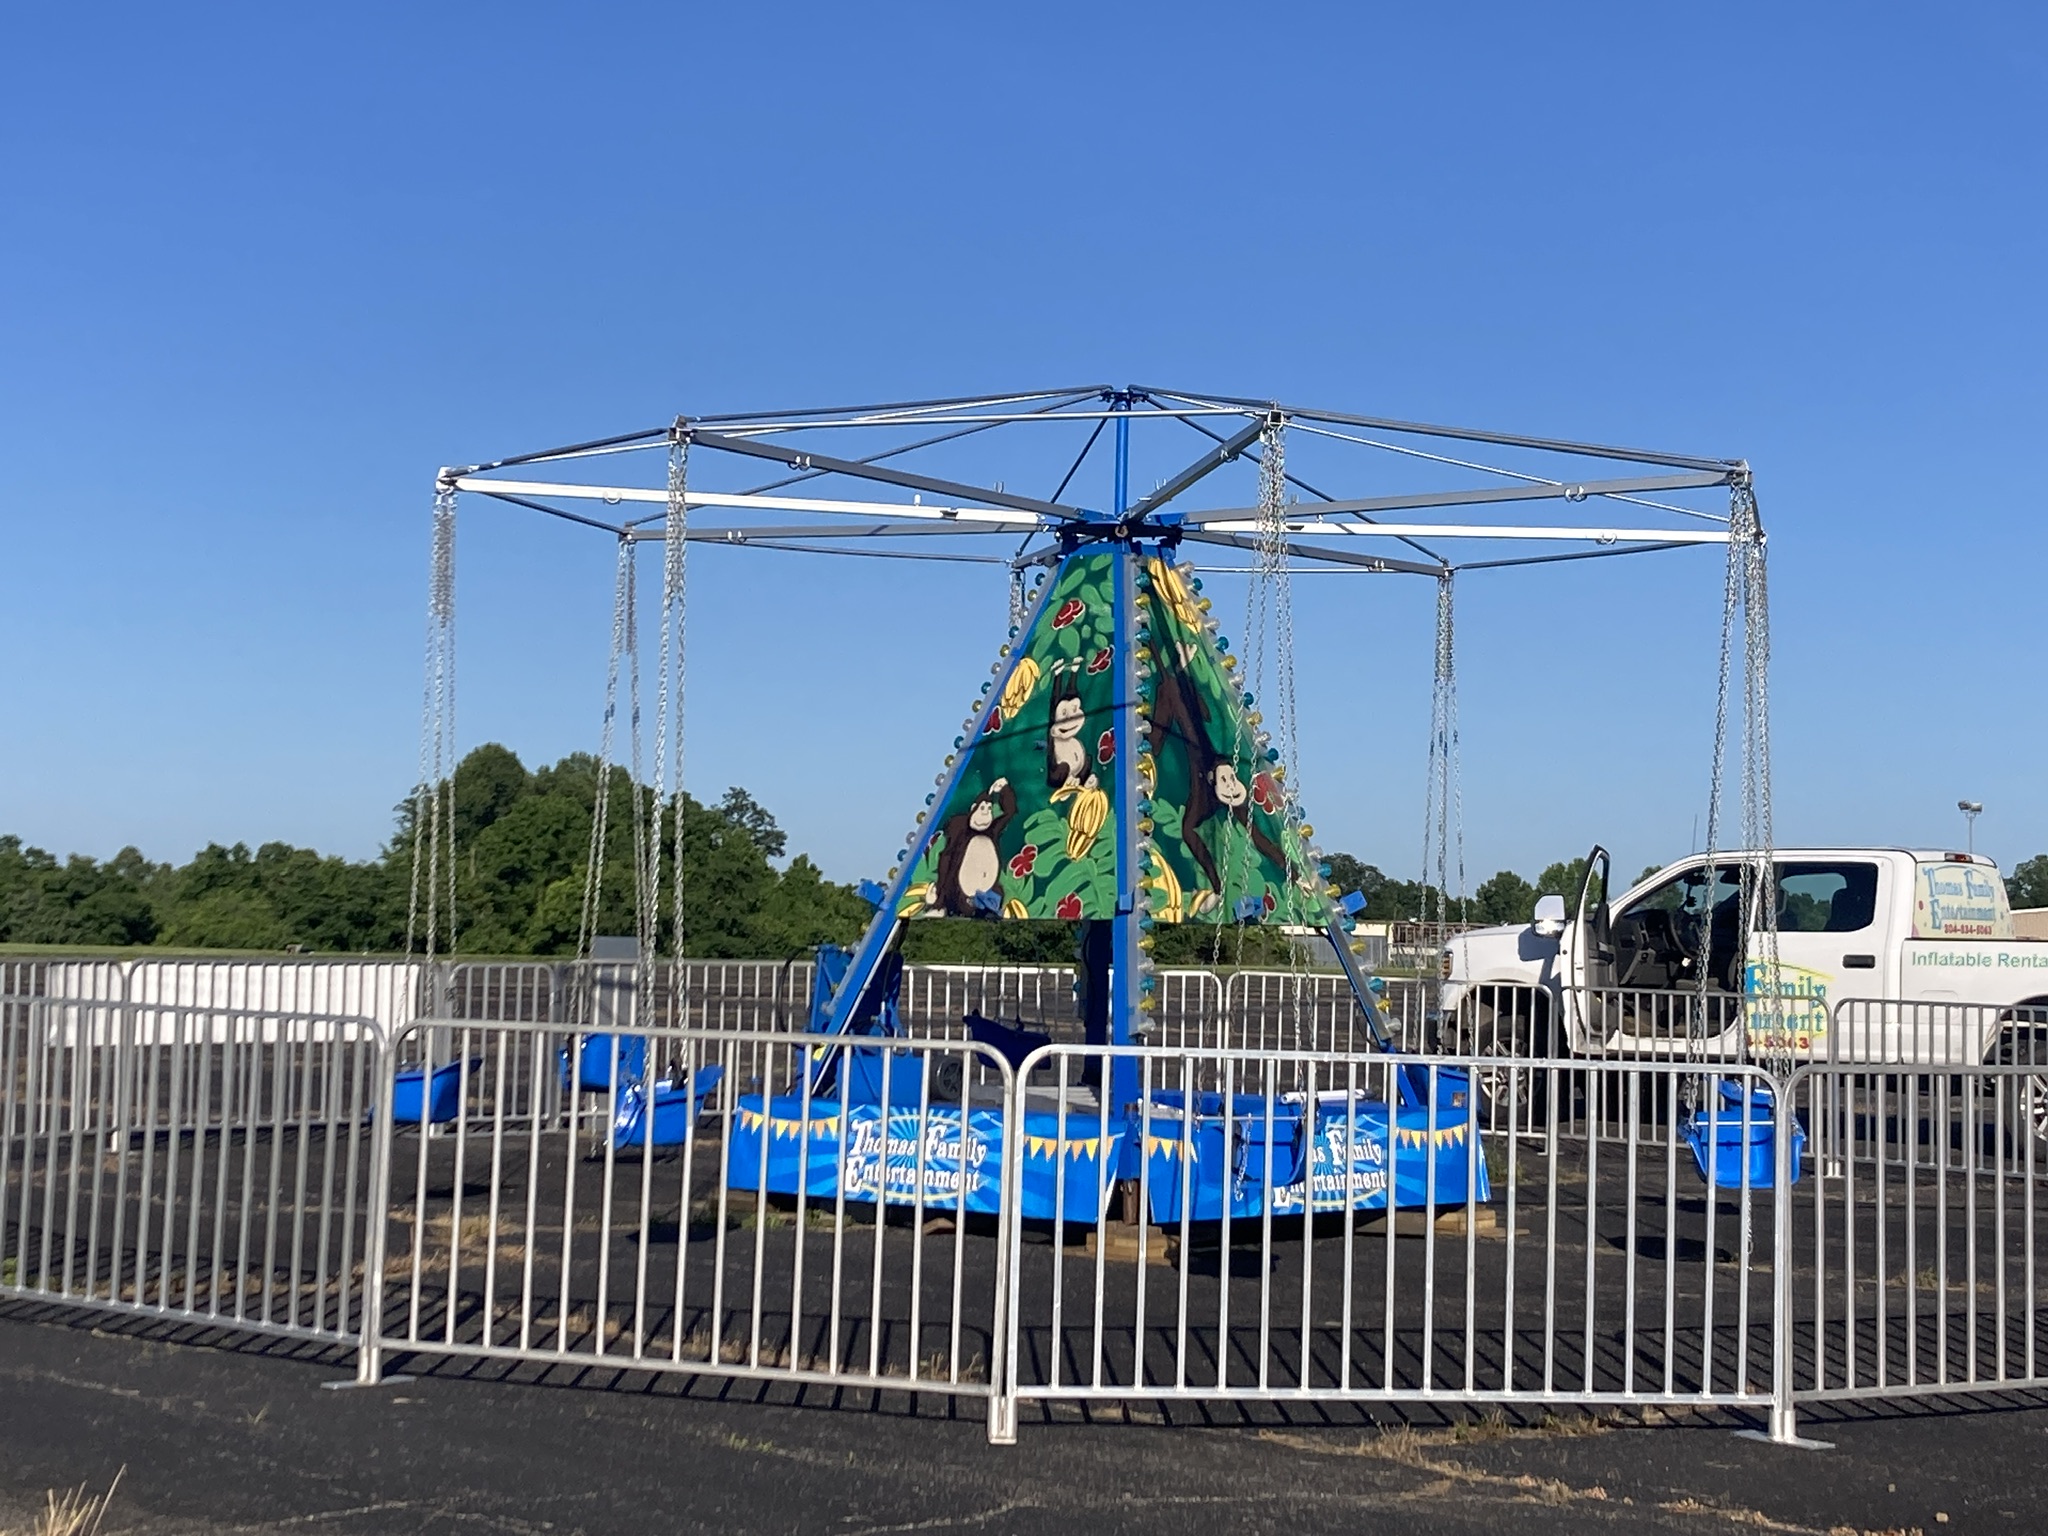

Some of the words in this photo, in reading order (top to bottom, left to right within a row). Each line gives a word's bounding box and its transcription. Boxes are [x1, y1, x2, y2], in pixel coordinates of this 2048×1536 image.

[1912, 951, 1993, 968] Inflatable
[1744, 963, 1827, 1010] Fmily
[848, 1119, 918, 1156] Thomas
[844, 1155, 981, 1193] Entrtanmet
[1271, 1168, 1388, 1208] Entrtainment
